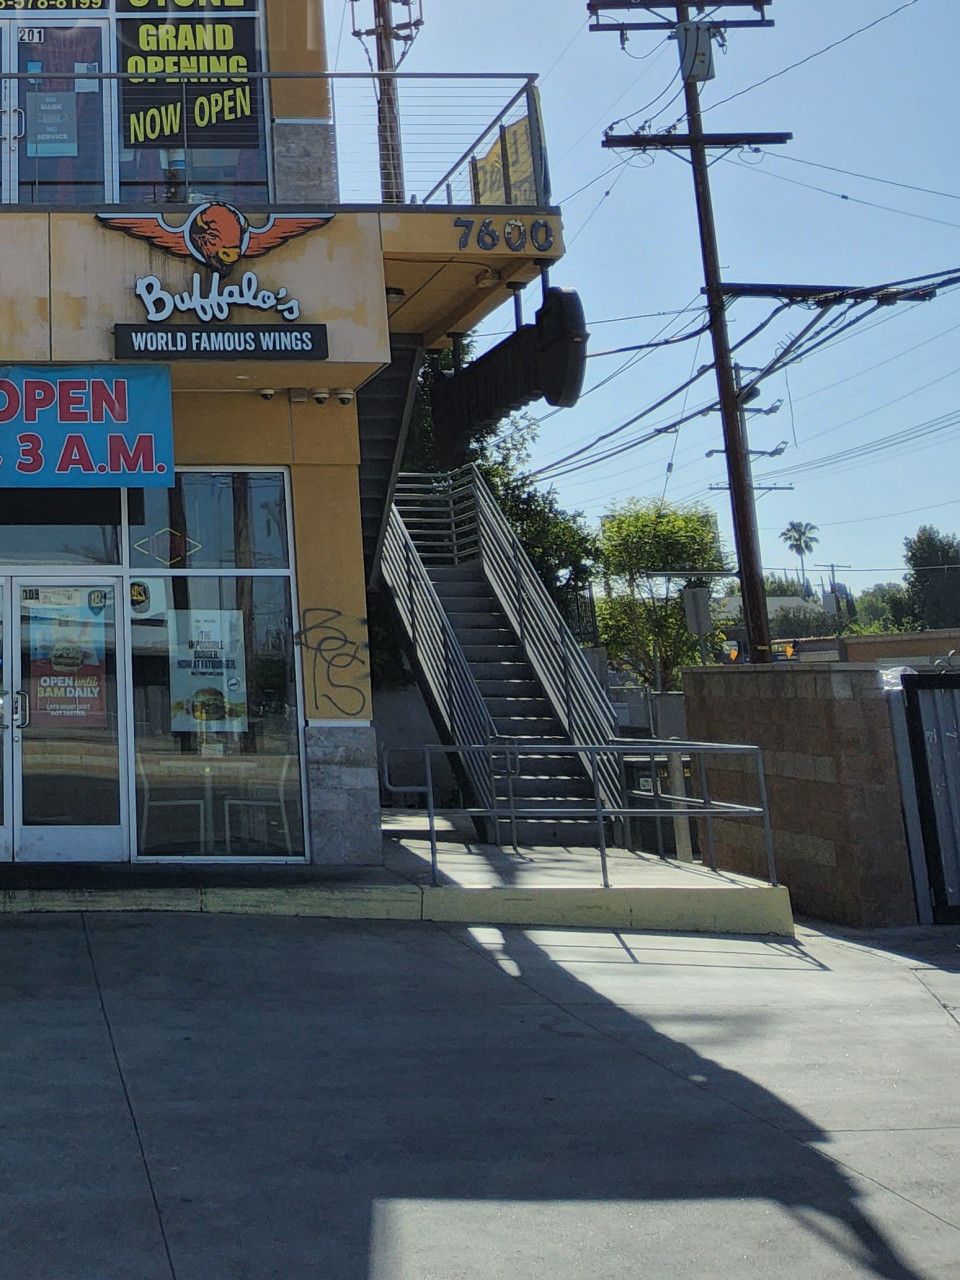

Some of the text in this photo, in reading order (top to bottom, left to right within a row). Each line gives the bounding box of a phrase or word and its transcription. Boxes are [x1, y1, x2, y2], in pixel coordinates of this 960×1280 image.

[18, 29, 44, 42] 201
[138, 24, 235, 52] GRAND
[127, 55, 249, 83] OPENING
[129, 85, 252, 145] NOW OPEN
[453, 217, 554, 252] 7600
[135, 271, 301, 322] Buffalo's
[131, 331, 313, 352] WORLD FAMOUS WINGS
[15, 432, 45, 474] 3
[54, 433, 167, 474] A.M.
[40, 676, 73, 687] OPEN
[66, 686, 100, 698] DAILY
